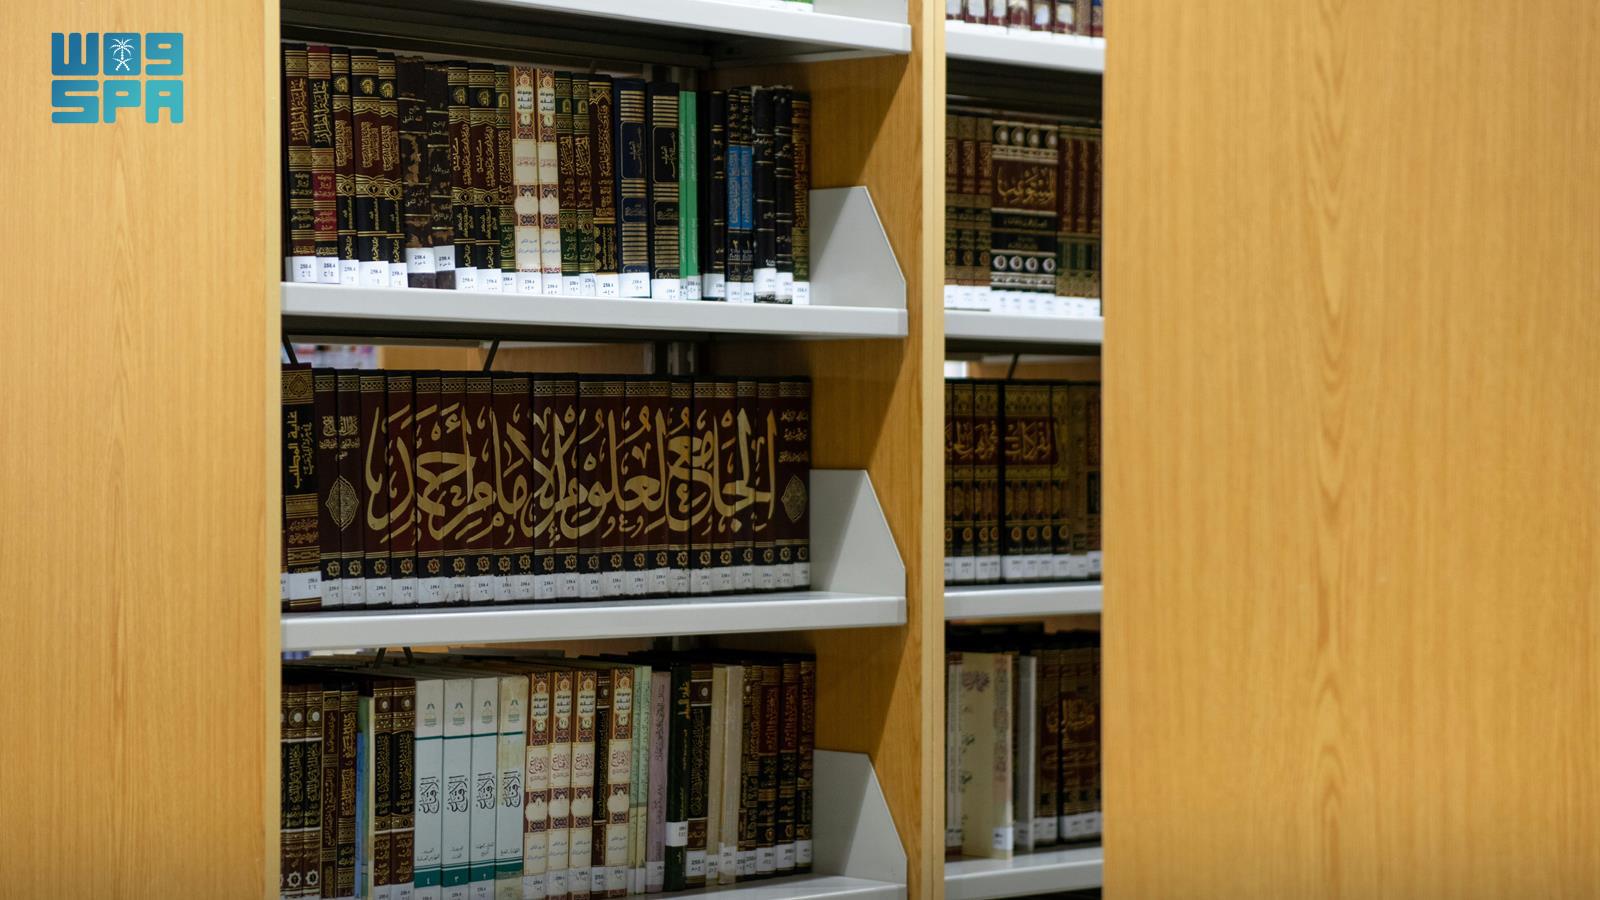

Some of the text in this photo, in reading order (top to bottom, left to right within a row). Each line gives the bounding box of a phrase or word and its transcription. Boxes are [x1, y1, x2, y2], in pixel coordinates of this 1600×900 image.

[287, 410, 303, 489] غاية المطلب
[665, 405, 777, 536] الجامع
[419, 776, 440, 814] الإقناع
[446, 775, 468, 813] الإقناع
[475, 772, 496, 810] الإقناع
[501, 771, 521, 808] الإقناع
